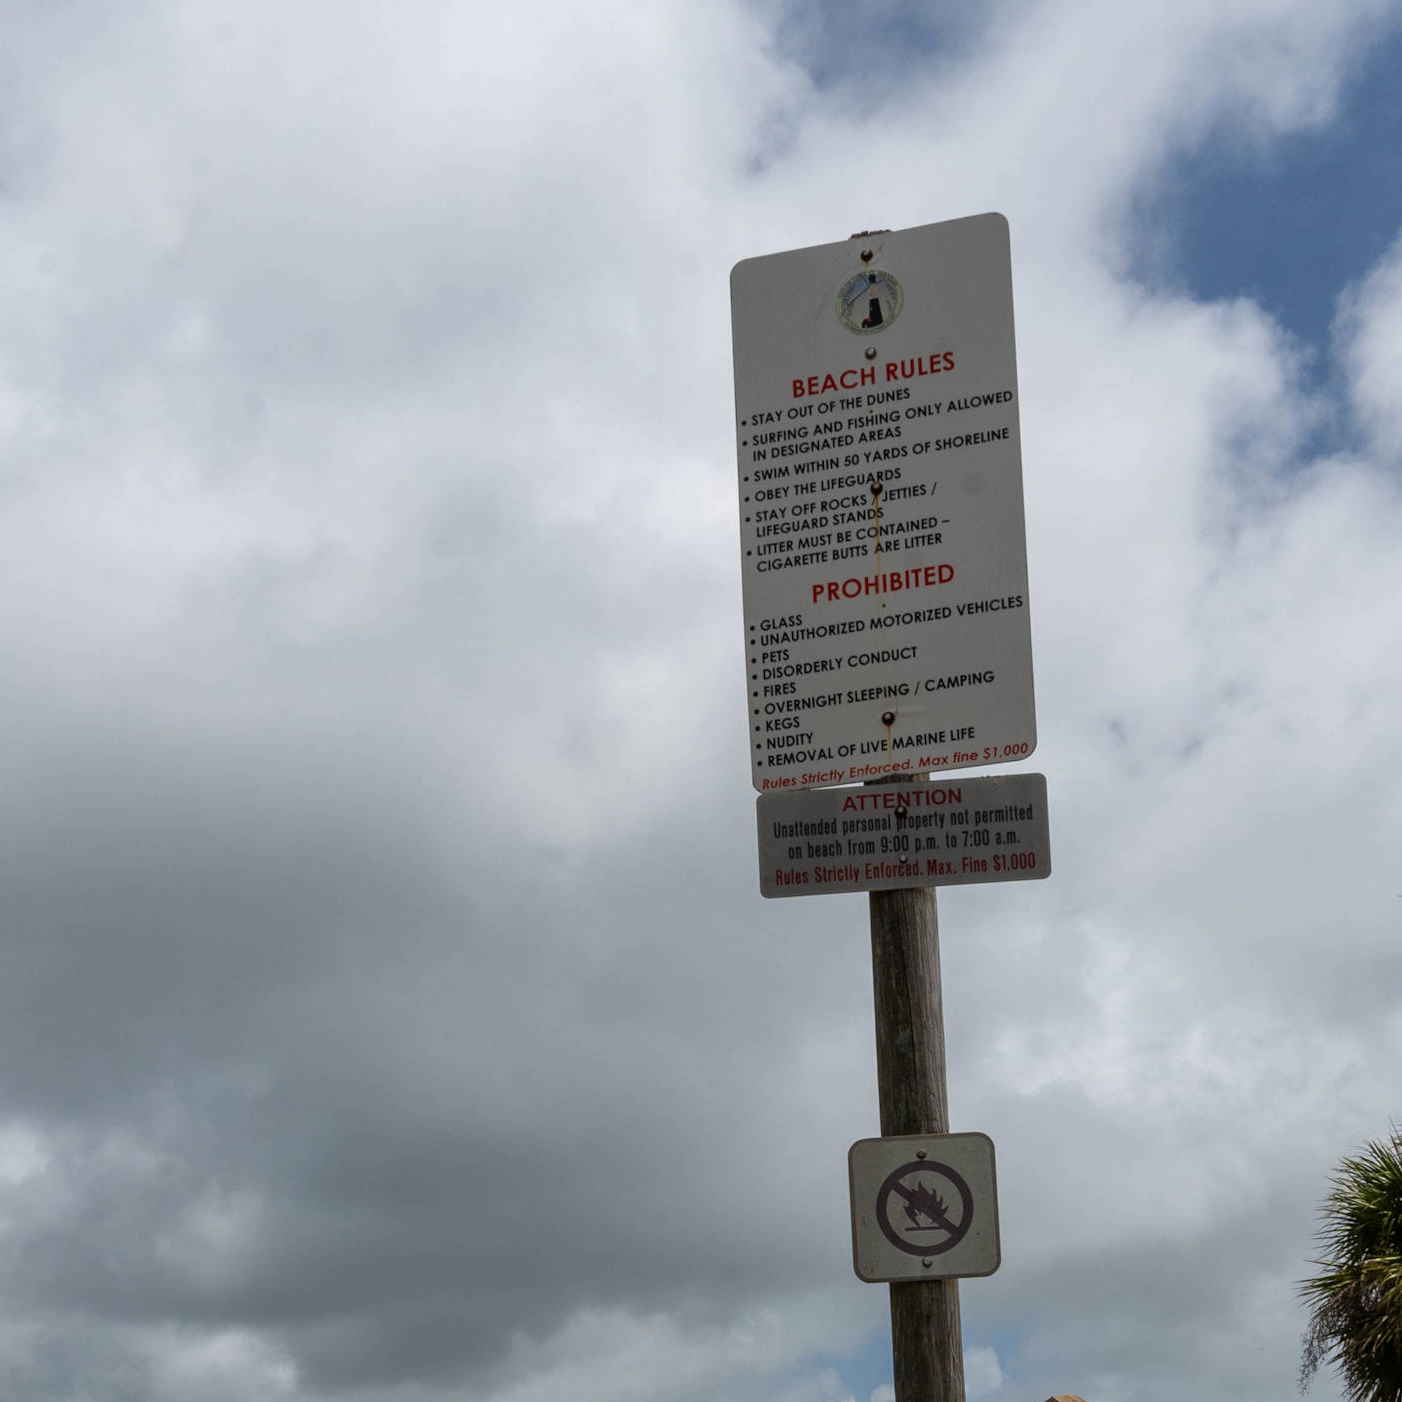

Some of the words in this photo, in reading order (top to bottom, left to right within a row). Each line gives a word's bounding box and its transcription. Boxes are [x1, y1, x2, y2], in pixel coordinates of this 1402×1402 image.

[793, 366, 875, 398] BEACH
[885, 351, 955, 381] RULES
[752, 410, 783, 426] STAY
[787, 404, 814, 419] OUT
[818, 401, 837, 414] OF
[839, 396, 862, 411] THE
[868, 388, 910, 406] DUNES
[752, 426, 809, 446] SURFING
[813, 420, 843, 436] AND
[848, 411, 901, 430] FISHING
[905, 403, 943, 419] ONLY
[947, 390, 1013, 412] ALLOWED
[753, 449, 767, 462] IN
[771, 435, 854, 458] DESIGNATED
[858, 426, 902, 445] AREAS
[754, 466, 790, 482] SWIM
[794, 457, 839, 474] WITHIN
[844, 454, 860, 467] 50
[864, 446, 908, 463] YARDS
[912, 441, 931, 455] OF
[935, 428, 1010, 451] SHORELINE
[755, 486, 790, 502] OBEY
[794, 483, 817, 496] THE
[821, 468, 902, 491] LIFEGUARDS
[756, 507, 787, 523] STAY
[791, 503, 817, 517] OFF
[821, 495, 867, 512] ROCKS
[882, 484, 927, 502] JETTIES
[756, 516, 828, 537] LIFEGUARD
[832, 508, 884, 525] STANDS
[757, 540, 793, 556] LITTER
[798, 534, 832, 550] MUST
[837, 531, 852, 543] BE
[856, 516, 938, 540] CONTAINED
[757, 552, 828, 572] CIGARETTE
[832, 545, 868, 560] BUTTS
[874, 540, 900, 554] ARE
[905, 533, 942, 549] LITTER
[812, 564, 954, 604] PROHIBITED
[760, 615, 803, 632] GLASS
[761, 620, 865, 647] UNAUTHORIZED
[870, 607, 951, 631] MOTORIZED
[956, 596, 1023, 617] VEHICLES
[762, 649, 790, 664] PETS
[763, 658, 843, 680] DISORDERLY
[848, 646, 918, 667] CONDUCT
[763, 682, 796, 697] FIRES
[765, 693, 843, 715] OVERNIGHT
[846, 683, 910, 704] SLEEPING
[925, 671, 995, 692] CAMPING
[766, 717, 800, 732] KEGS
[766, 732, 813, 749] NUDITY
[768, 746, 834, 767] REMOVAL
[837, 744, 857, 757] OF
[860, 739, 888, 754] LIVE
[892, 731, 946, 749] MARINE
[950, 726, 975, 740] LIFE
[762, 776, 797, 790] Rules
[801, 769, 845, 785] Strictly
[849, 759, 914, 778] Enforced.
[918, 756, 948, 768] Max
[952, 752, 978, 763] fine
[843, 788, 962, 812] ATTENTION
[774, 817, 837, 838] Unattended
[843, 814, 891, 836] personal
[897, 811, 945, 832] property
[950, 810, 969, 825] not
[975, 803, 1033, 826] permitted
[788, 847, 802, 859] on
[807, 840, 842, 858] beach
[848, 839, 875, 855] from
[880, 835, 909, 853] 9:00
[915, 837, 940, 853] p.m.
[946, 833, 957, 848] to
[962, 829, 990, 847] 7:00
[995, 831, 1020, 845] a.m.
[775, 868, 809, 886] Rules
[814, 864, 859, 883] Strictly
[865, 860, 923, 879] Enforced.
[927, 859, 957, 876] Max.
[962, 856, 987, 873] Fine
